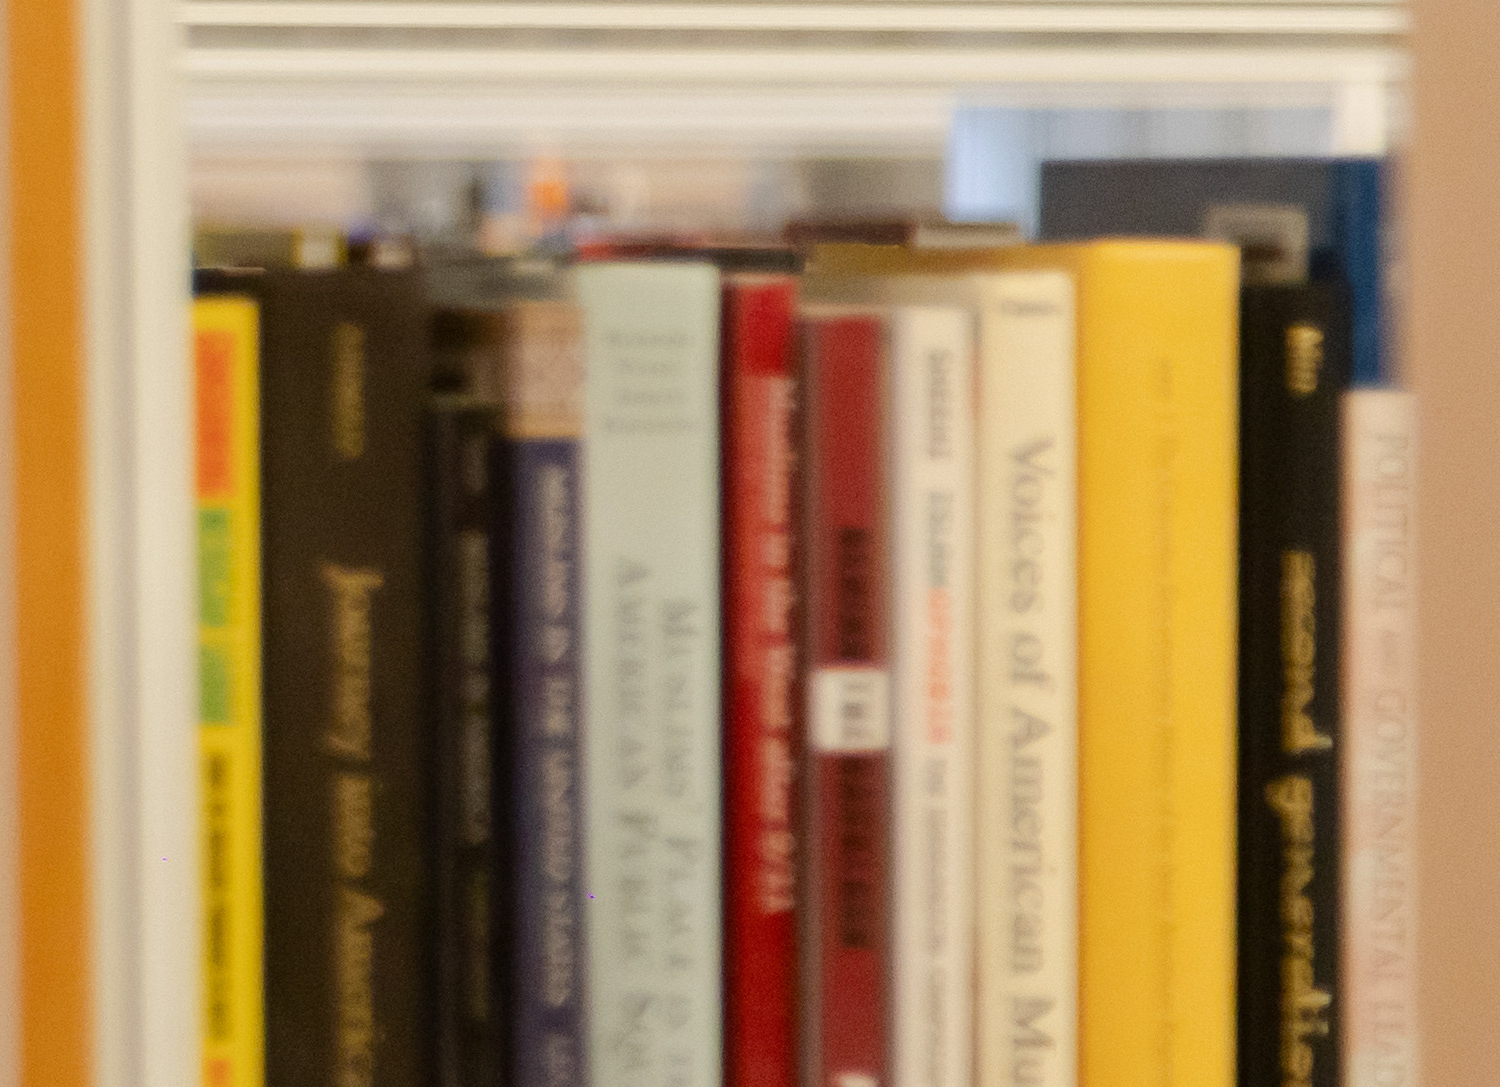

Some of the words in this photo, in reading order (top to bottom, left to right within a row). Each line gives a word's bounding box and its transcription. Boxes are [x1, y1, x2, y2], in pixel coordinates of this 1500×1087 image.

[1008, 436, 1056, 613] Voices
[322, 565, 385, 760] Journey
[1008, 633, 1056, 686] of
[1280, 550, 1331, 755] second
[336, 772, 380, 877] into
[1008, 706, 1056, 977] American
